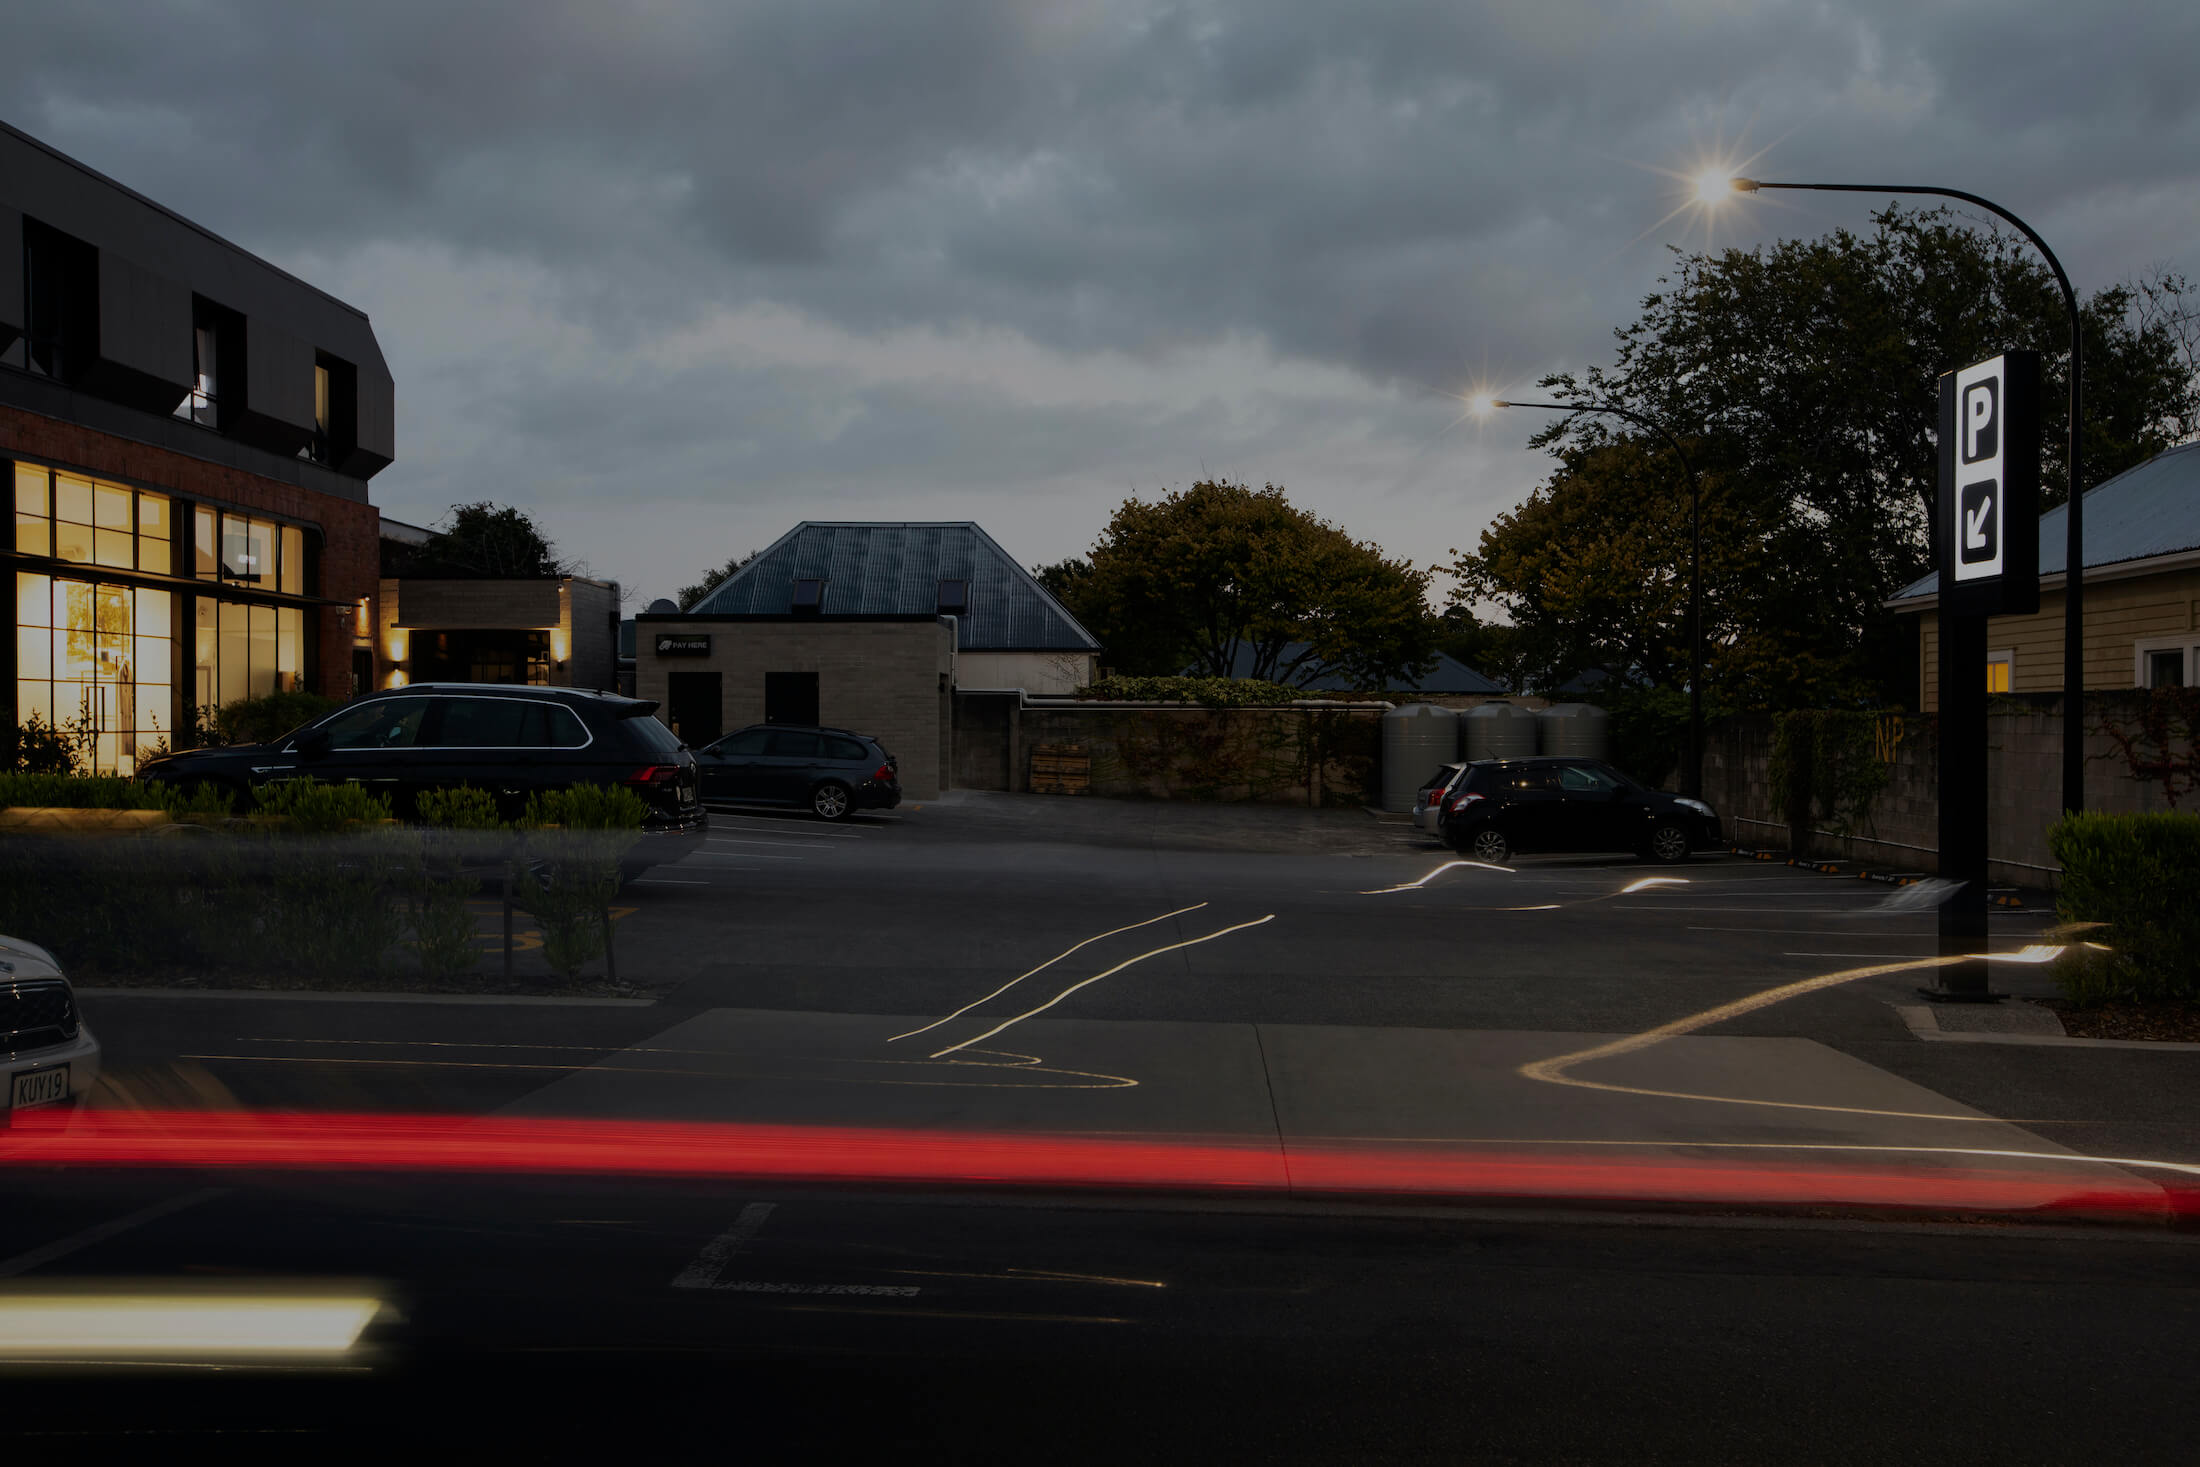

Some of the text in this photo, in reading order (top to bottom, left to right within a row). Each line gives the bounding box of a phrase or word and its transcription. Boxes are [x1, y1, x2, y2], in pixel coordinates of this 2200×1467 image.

[1967, 386, 1993, 459] P
[672, 641, 707, 649] PAY HERE
[1875, 715, 1904, 763] NP
[19, 1072, 62, 1105] KUY19
